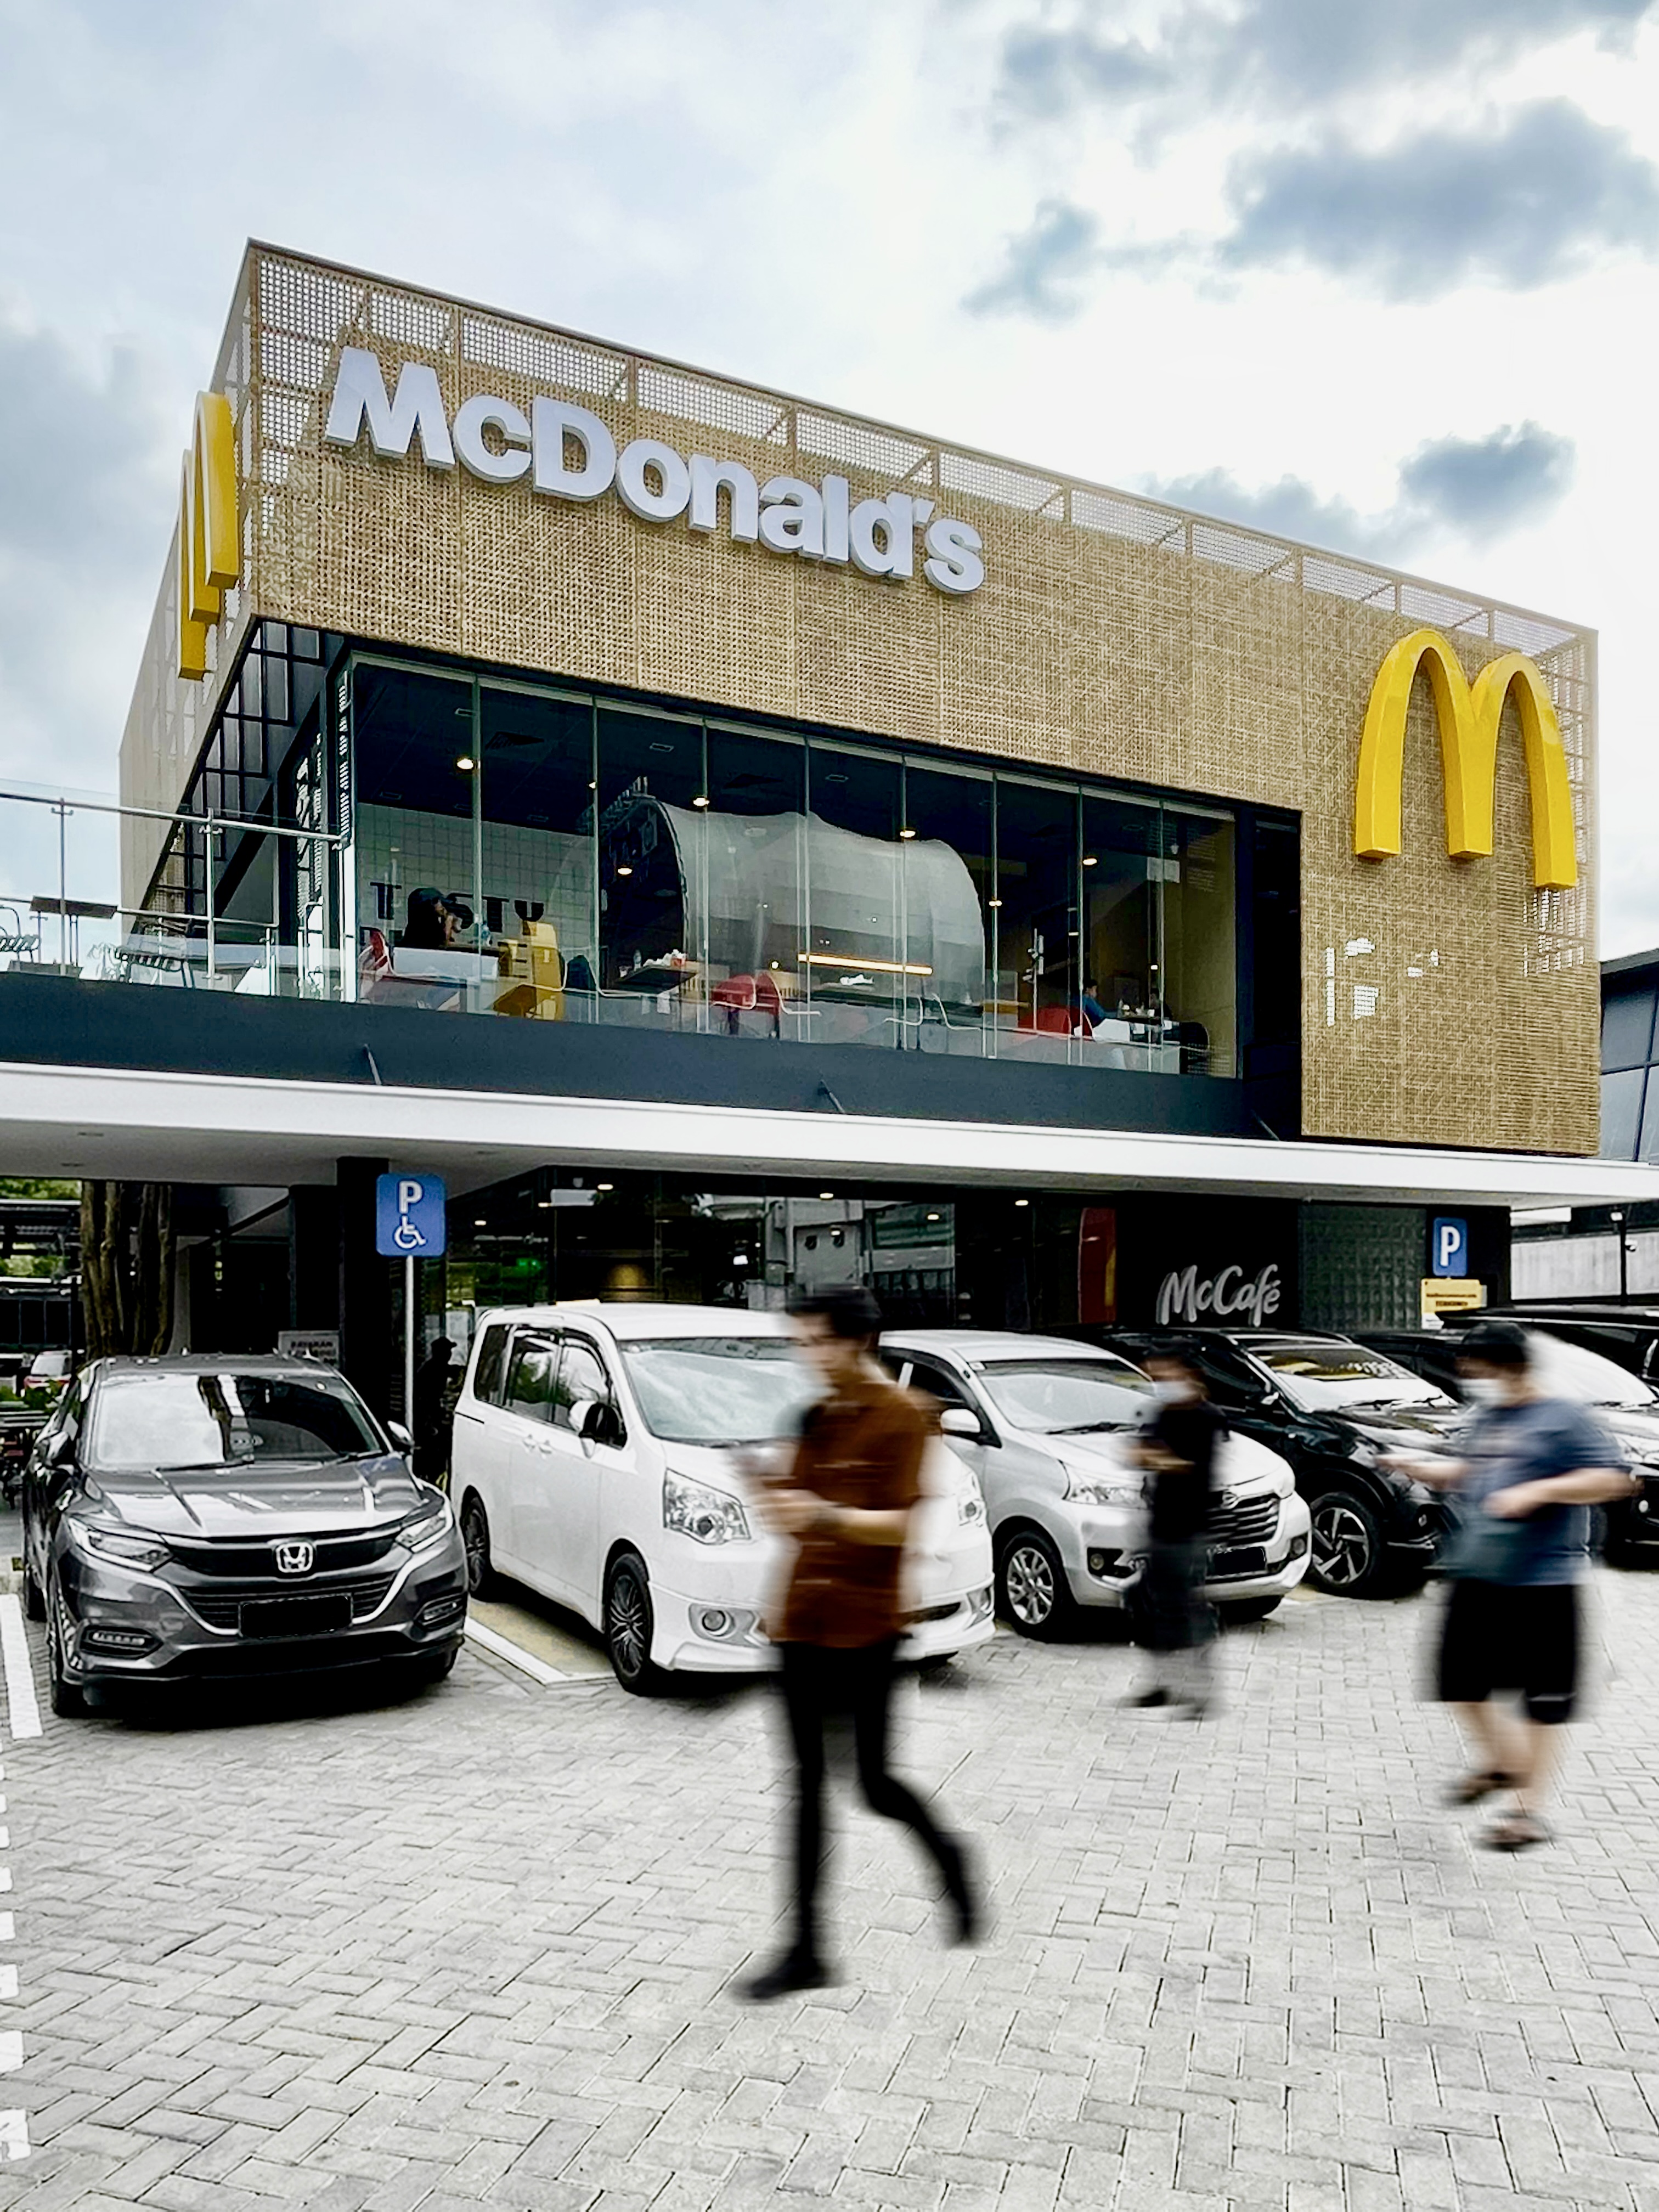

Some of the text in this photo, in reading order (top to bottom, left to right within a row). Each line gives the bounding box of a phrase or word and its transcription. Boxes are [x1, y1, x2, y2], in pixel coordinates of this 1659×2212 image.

[327, 346, 985, 595] McDonald's
[399, 1181, 422, 1214] P
[1440, 1226, 1460, 1267] P
[1156, 1263, 1281, 1327] McCafé
